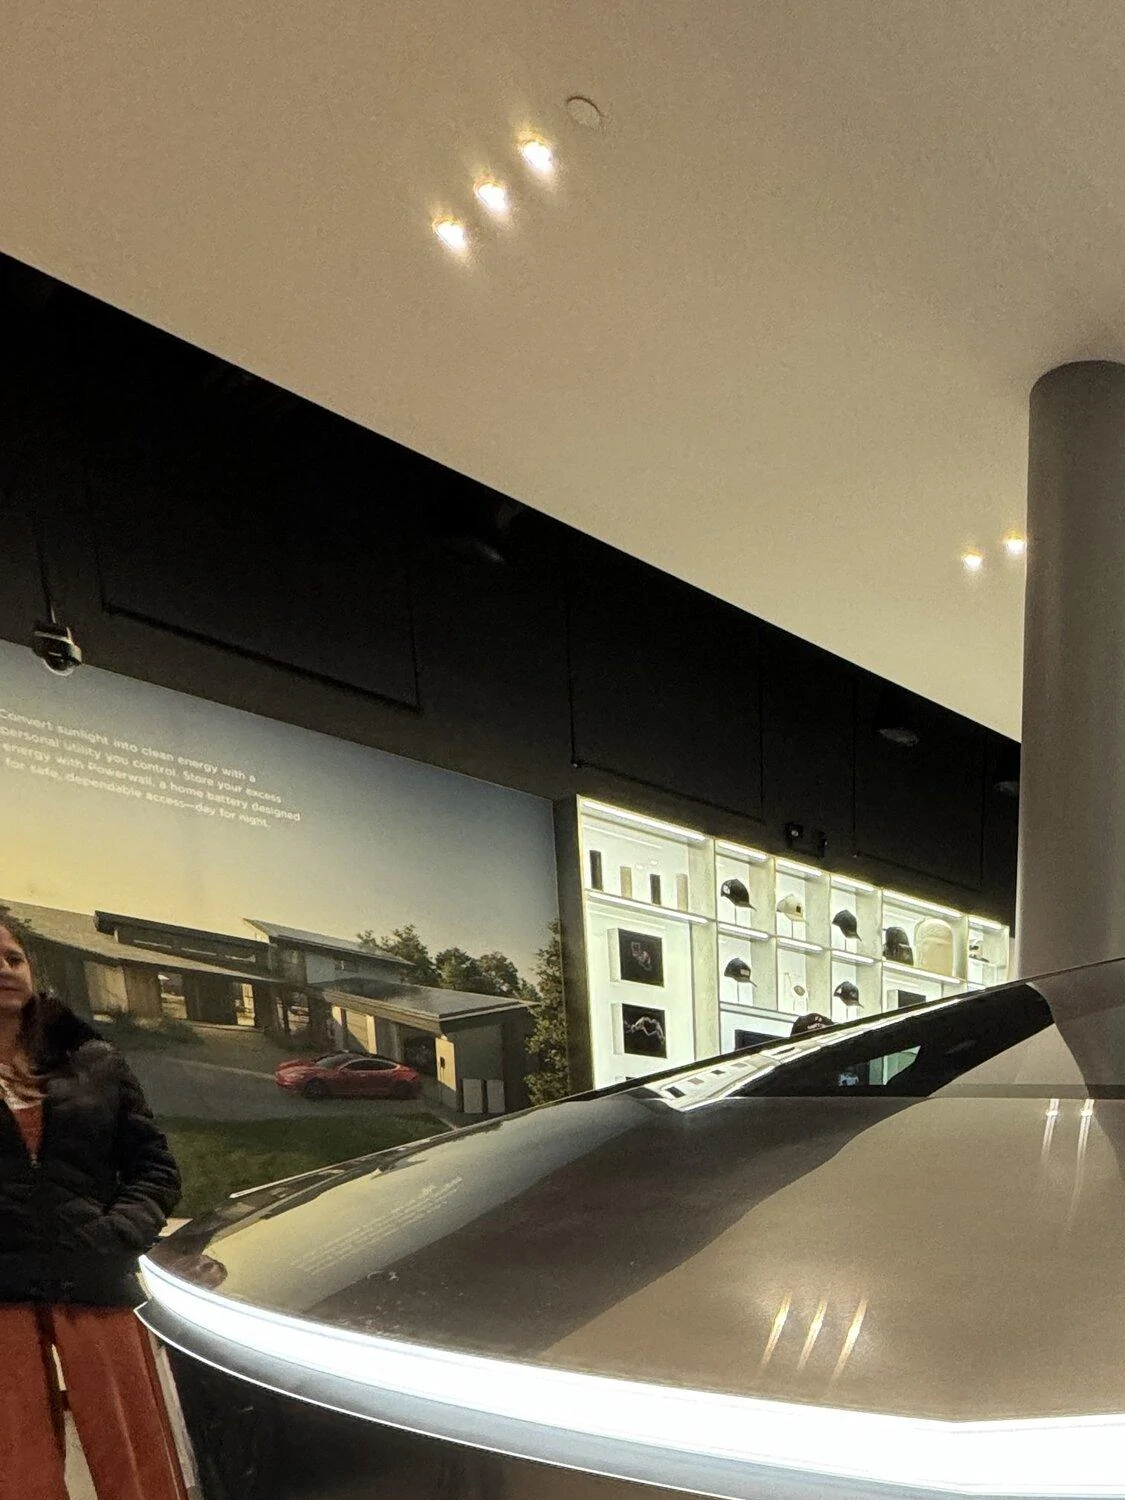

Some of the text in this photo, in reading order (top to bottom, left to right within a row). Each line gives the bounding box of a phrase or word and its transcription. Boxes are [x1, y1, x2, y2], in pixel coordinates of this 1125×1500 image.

[0, 708, 256, 783] Convert sunlight into clean energy with a
[2, 743, 50, 762] energy
[56, 756, 84, 769] with
[159, 781, 166, 789] a
[170, 782, 204, 798] home
[207, 791, 249, 809] battery
[251, 802, 301, 821] designed
[5, 758, 25, 769] for
[66, 772, 142, 798] dependable
[105, 752, 128, 765] you
[183, 771, 214, 786] Store
[217, 781, 243, 794] your
[245, 788, 282, 804] excess
